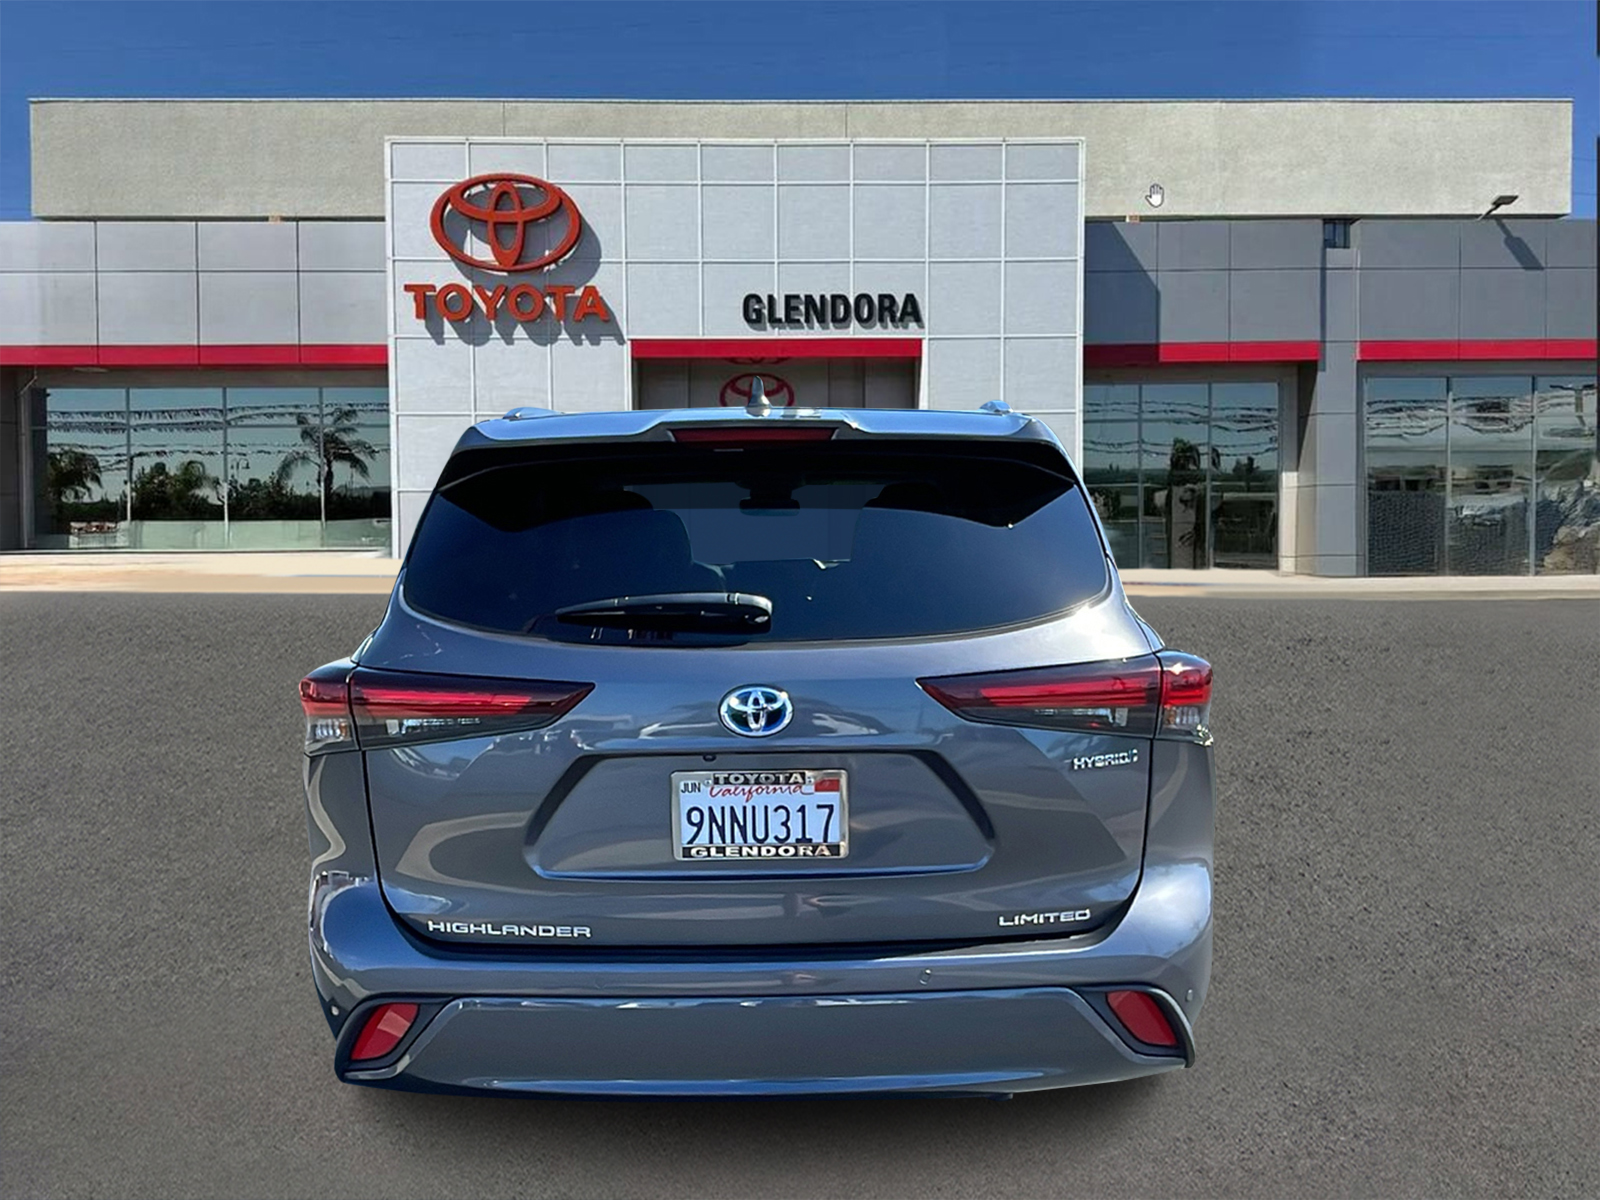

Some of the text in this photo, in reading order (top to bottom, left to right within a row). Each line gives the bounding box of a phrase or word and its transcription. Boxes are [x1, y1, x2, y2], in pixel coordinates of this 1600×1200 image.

[404, 283, 610, 324] TOYOTA
[742, 293, 922, 324] GLENDORA
[1073, 751, 1132, 770] HYBRID
[680, 783, 701, 793] JUN
[714, 773, 805, 785] TOYOTA
[685, 804, 835, 845] 9NNU317
[690, 846, 831, 858] GLENDORA
[998, 909, 1092, 927] LIMITED
[427, 920, 592, 938] HIGHLANDER
